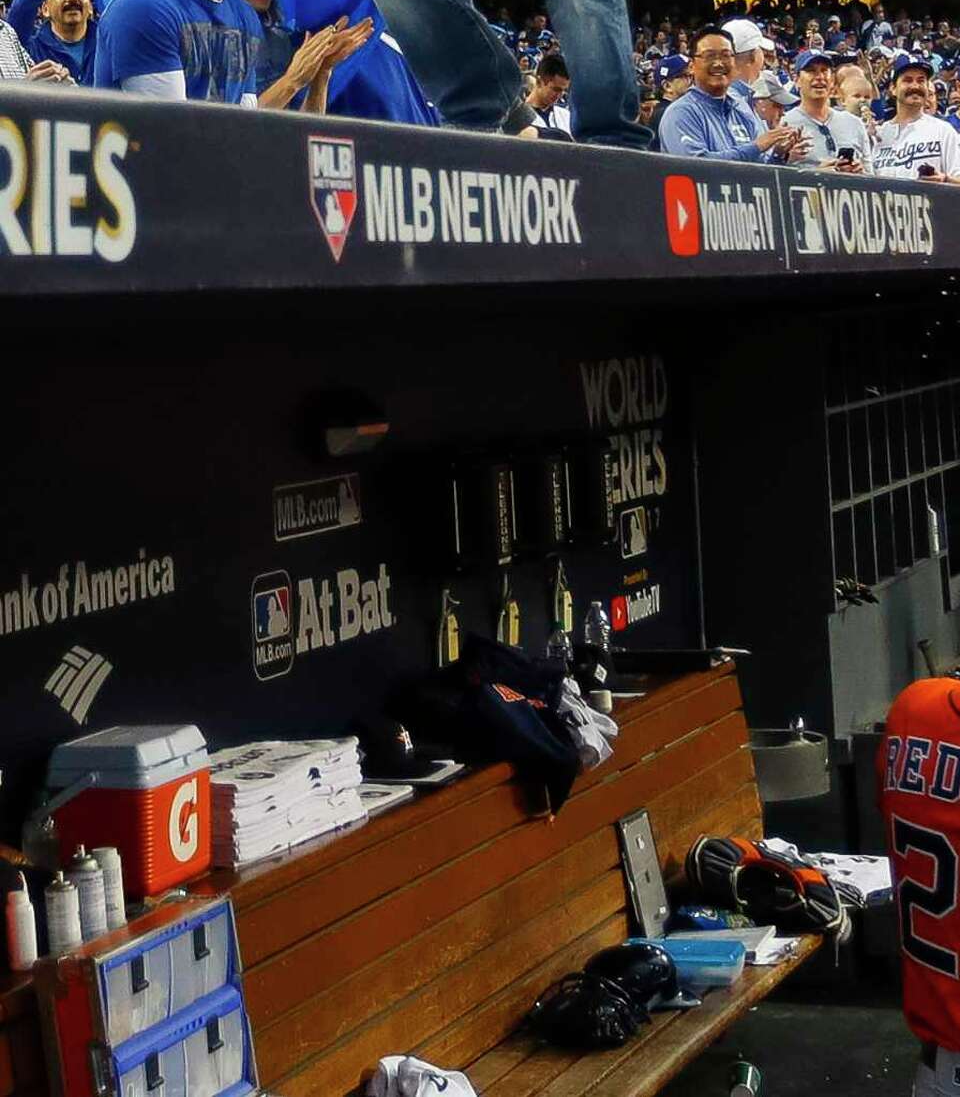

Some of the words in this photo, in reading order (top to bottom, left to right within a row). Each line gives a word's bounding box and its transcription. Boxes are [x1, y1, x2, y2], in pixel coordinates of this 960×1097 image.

[0, 116, 137, 262] RIES
[313, 143, 352, 177] MLB
[363, 163, 436, 243] MLB
[438, 168, 582, 245] NETWORK
[820, 184, 886, 253] WORLD
[884, 190, 935, 255] SERIES
[579, 355, 667, 426] WORLD
[275, 493, 339, 533] MLB.com
[42, 563, 70, 624] of
[73, 547, 175, 617] America
[296, 577, 336, 654] At
[336, 563, 393, 642] Bat
[255, 642, 292, 666] MLB.com
[168, 778, 198, 862] G
